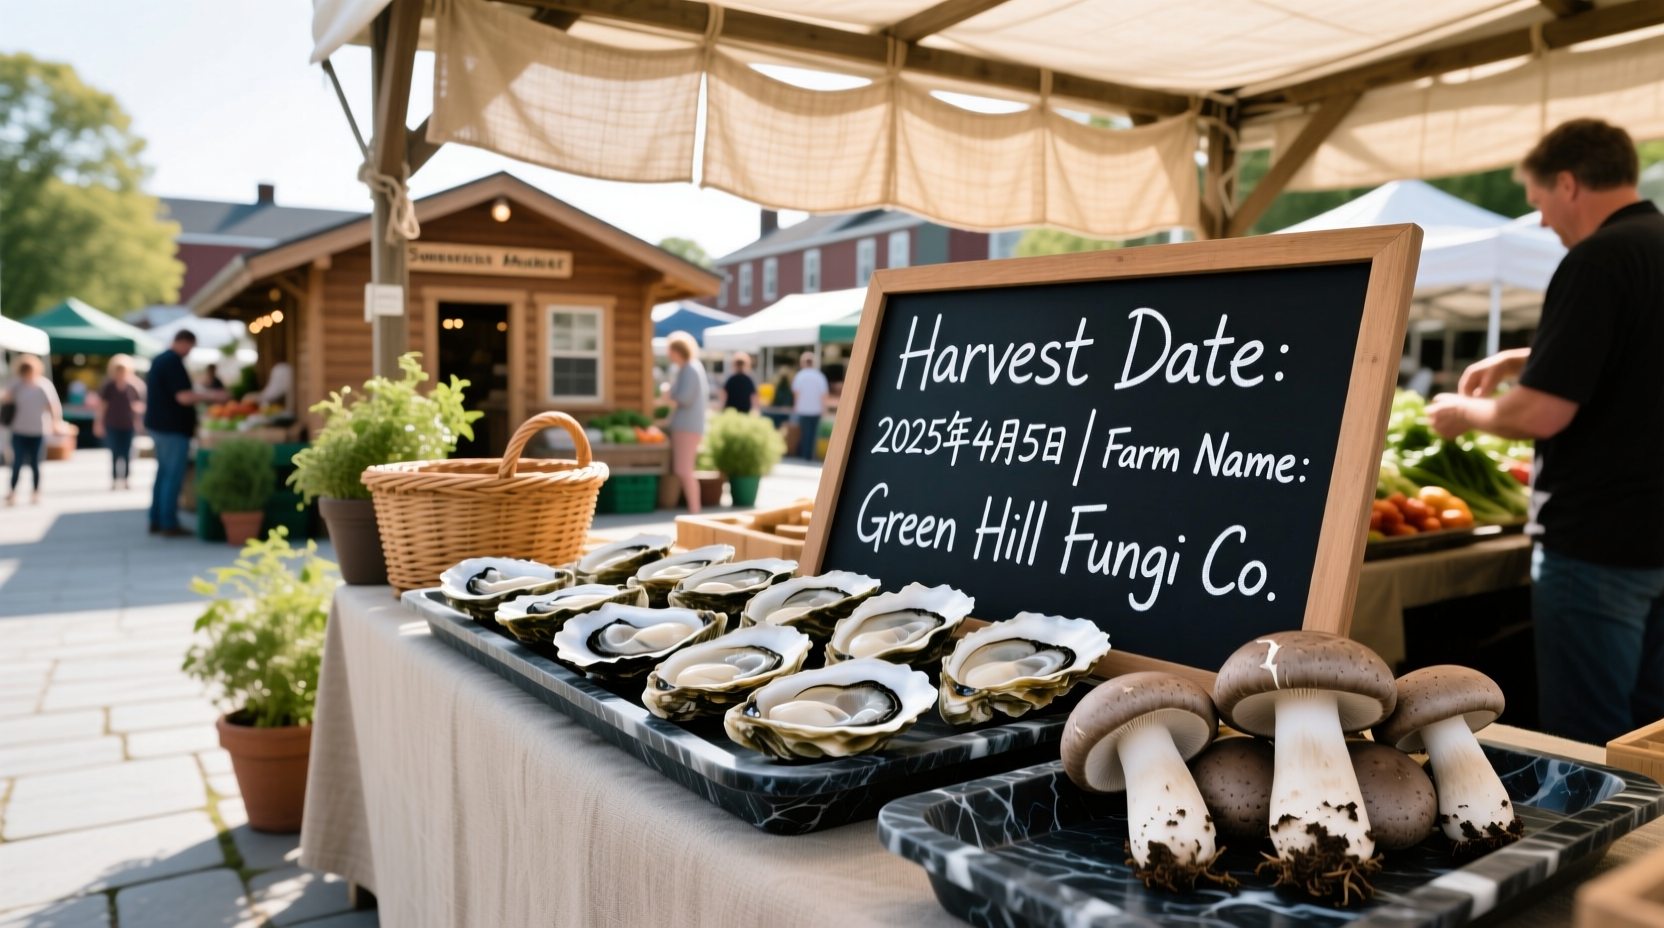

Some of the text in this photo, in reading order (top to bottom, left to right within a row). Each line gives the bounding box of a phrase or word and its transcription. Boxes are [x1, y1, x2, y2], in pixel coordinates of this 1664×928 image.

[895, 307, 1290, 392] Harvest Date:
[870, 410, 1067, 467] 2025年4月5日
[1101, 426, 1180, 475] Farm
[1192, 431, 1310, 484] Name:
[856, 482, 1276, 612] Green Hill Fungi Co.
